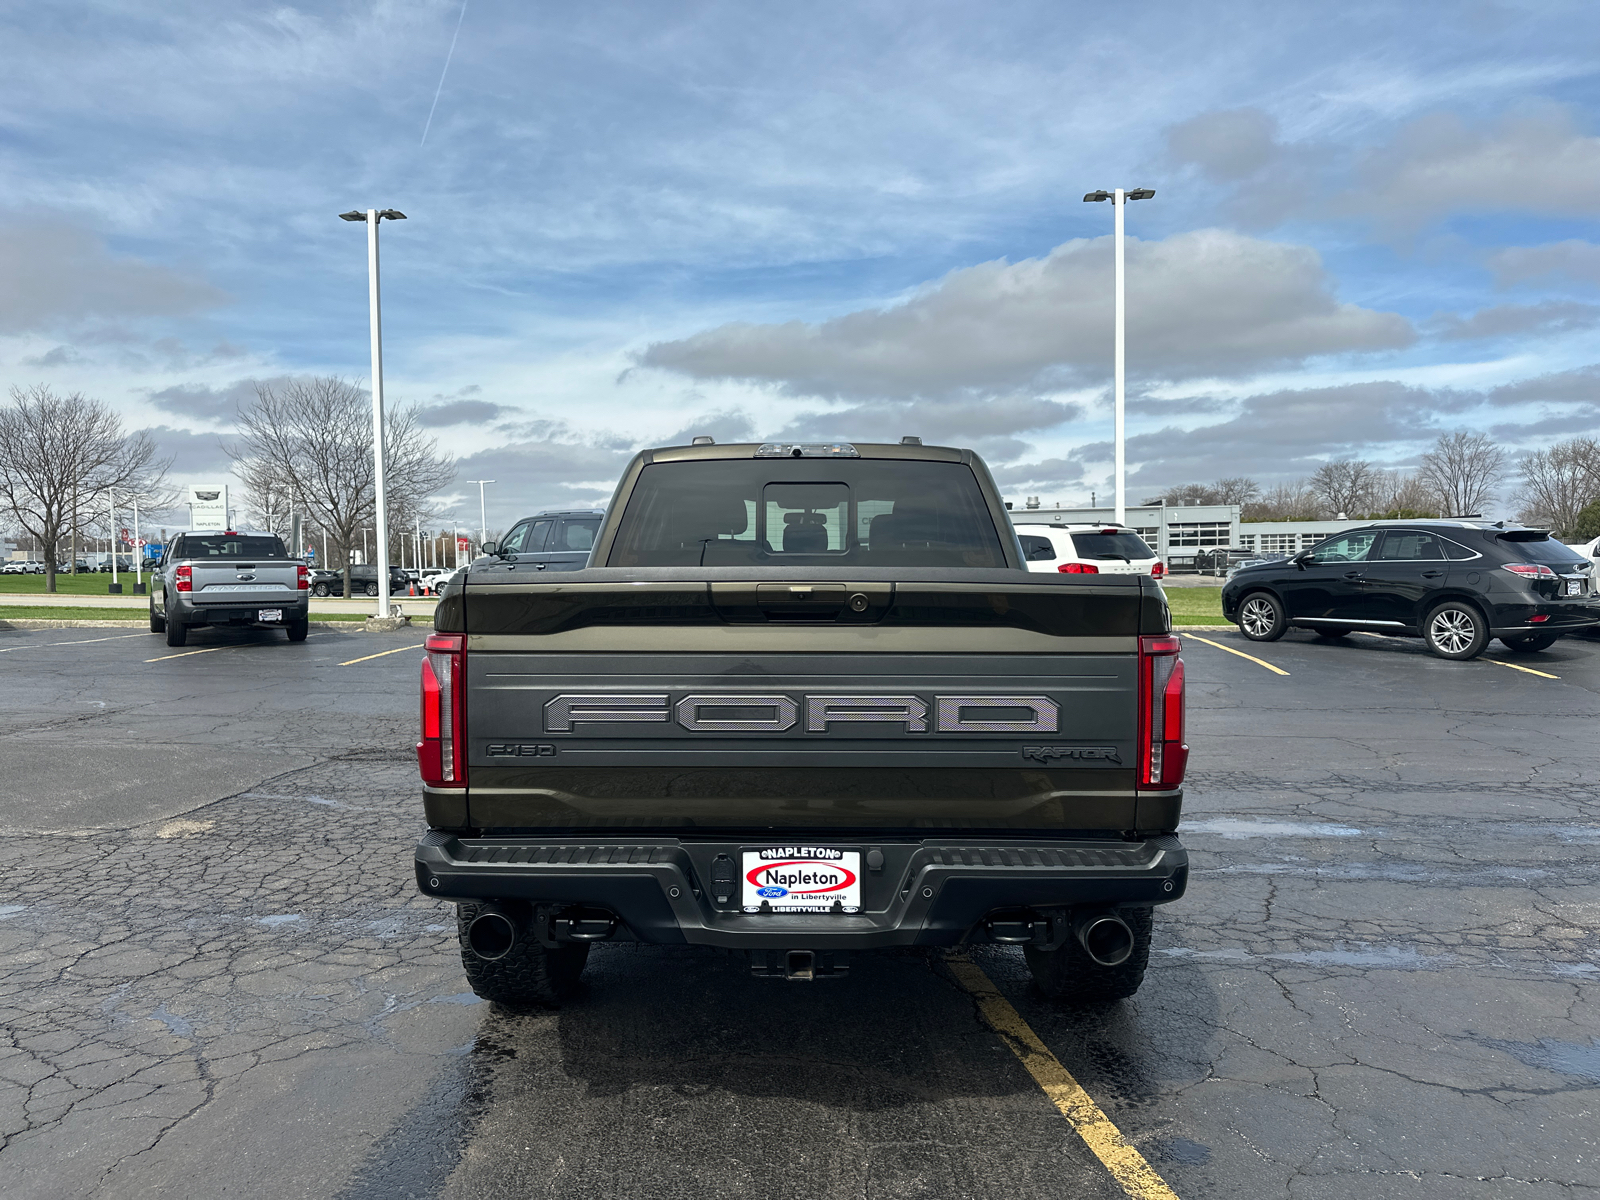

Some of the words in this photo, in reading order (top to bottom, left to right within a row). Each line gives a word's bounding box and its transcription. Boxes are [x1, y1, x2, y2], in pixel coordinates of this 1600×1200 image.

[543, 694, 1062, 734] FORD
[486, 744, 557, 757] F-150
[1022, 746, 1122, 764] RAPTOR
[767, 847, 836, 859] NAPLETON
[766, 869, 838, 888] Napleton
[762, 888, 782, 897] Ford
[801, 893, 847, 901] Libertyville
